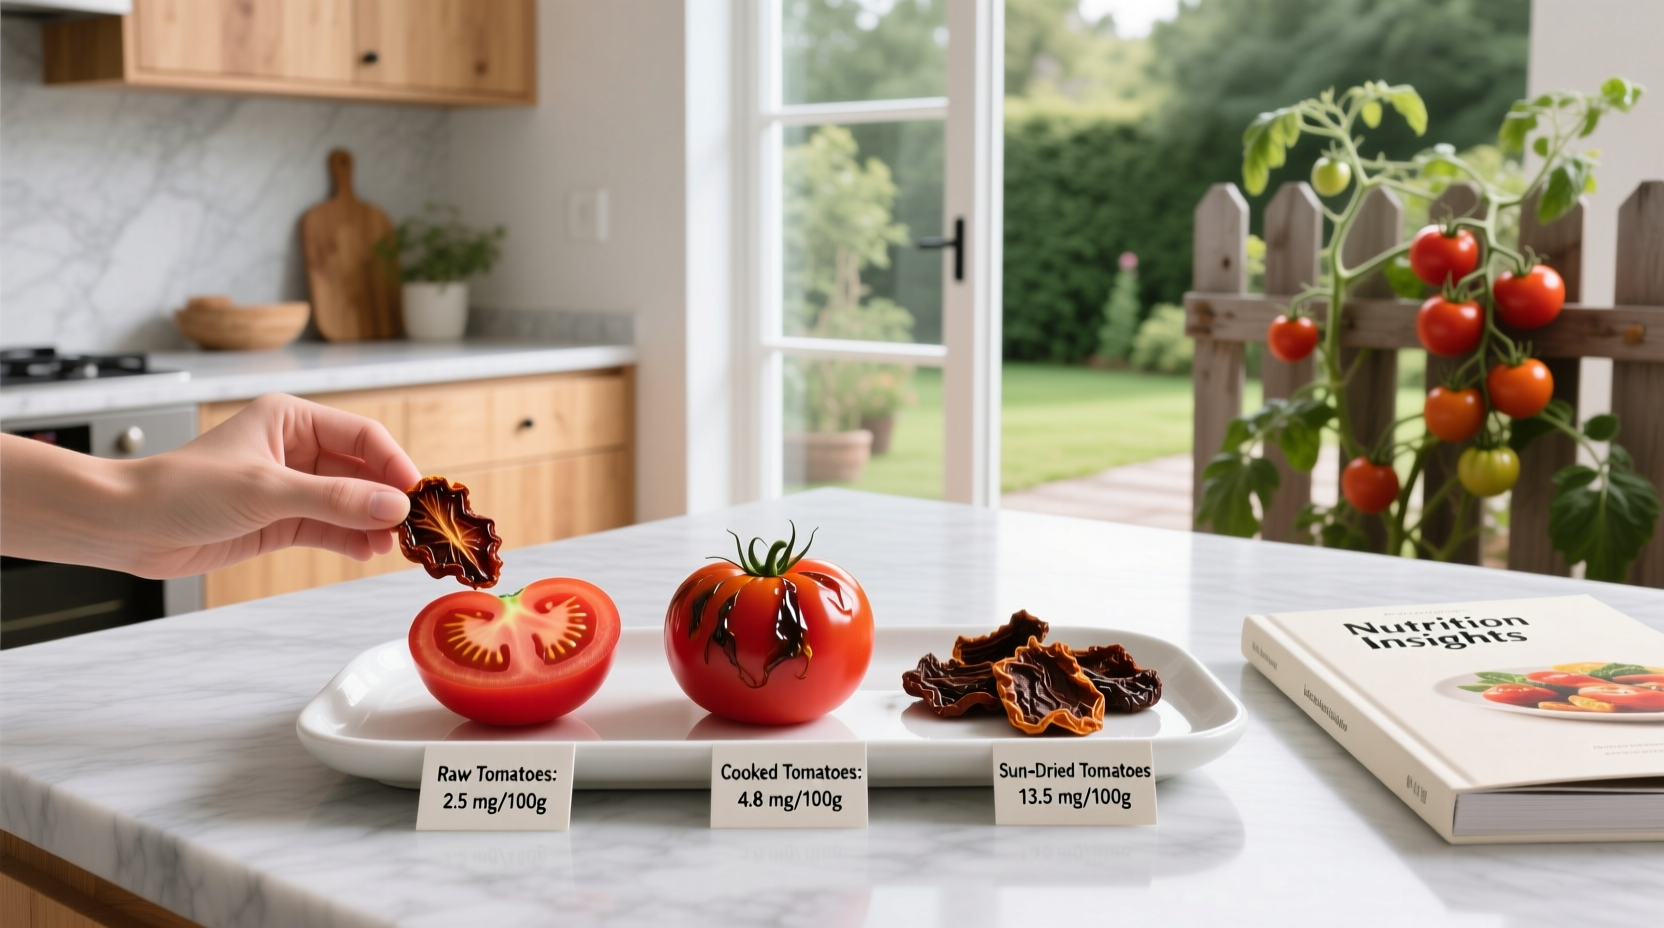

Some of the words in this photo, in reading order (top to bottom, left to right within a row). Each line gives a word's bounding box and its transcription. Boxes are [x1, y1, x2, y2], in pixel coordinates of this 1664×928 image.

[1343, 616, 1530, 636] Nutrition
[1361, 630, 1528, 650] Insights
[437, 765, 473, 783] Raw
[476, 765, 557, 783] Tomatoes:
[720, 762, 778, 781] Cooked
[782, 762, 862, 781] Tomatoes:
[999, 761, 1075, 779] Sun-Dried
[1078, 762, 1152, 779] Tomatoes
[442, 792, 468, 810] 2.5
[472, 791, 548, 816] mg/100g
[737, 790, 764, 808] 4.8
[768, 789, 843, 813] mg/100g
[1018, 787, 1053, 805] 13.5
[1058, 786, 1132, 810] mg/100g
